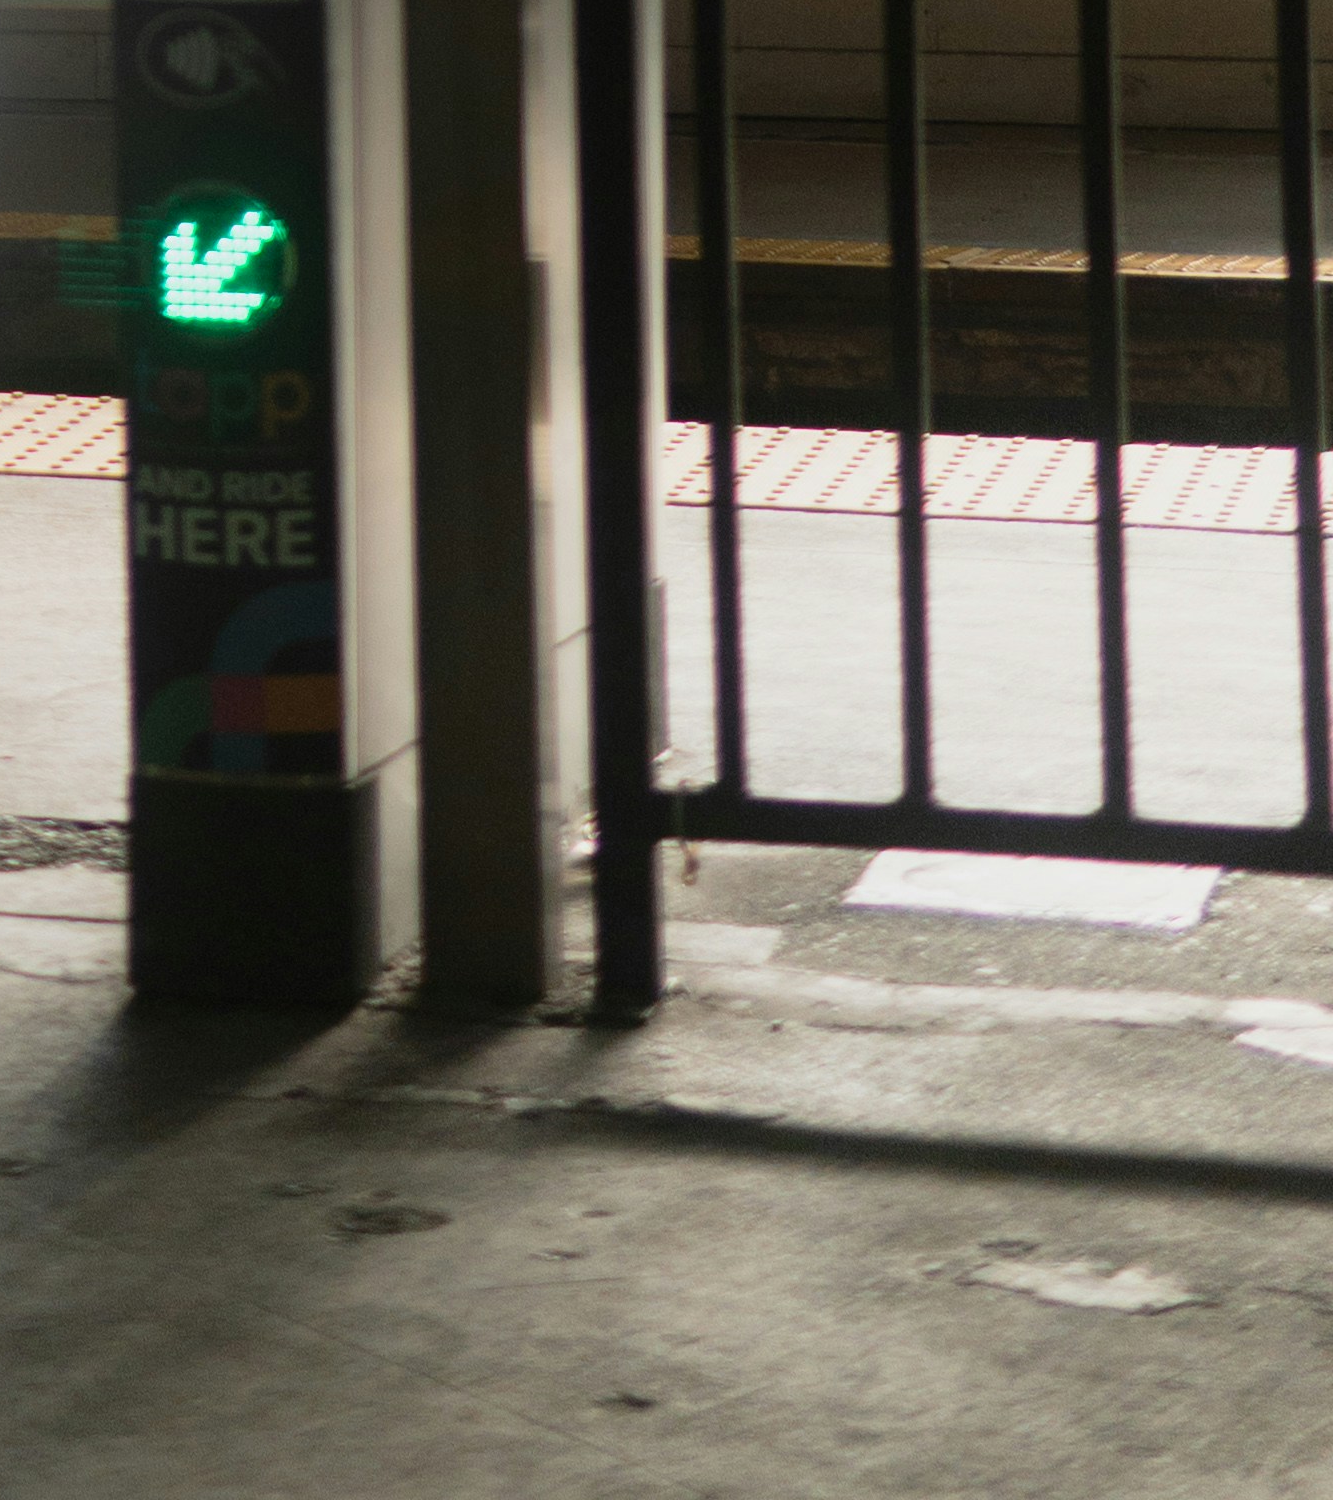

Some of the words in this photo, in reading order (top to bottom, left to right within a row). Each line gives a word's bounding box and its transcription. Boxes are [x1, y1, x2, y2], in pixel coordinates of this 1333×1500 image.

[134, 464, 214, 503] AND
[220, 469, 317, 503] RIDE
[133, 506, 318, 568] HERE
